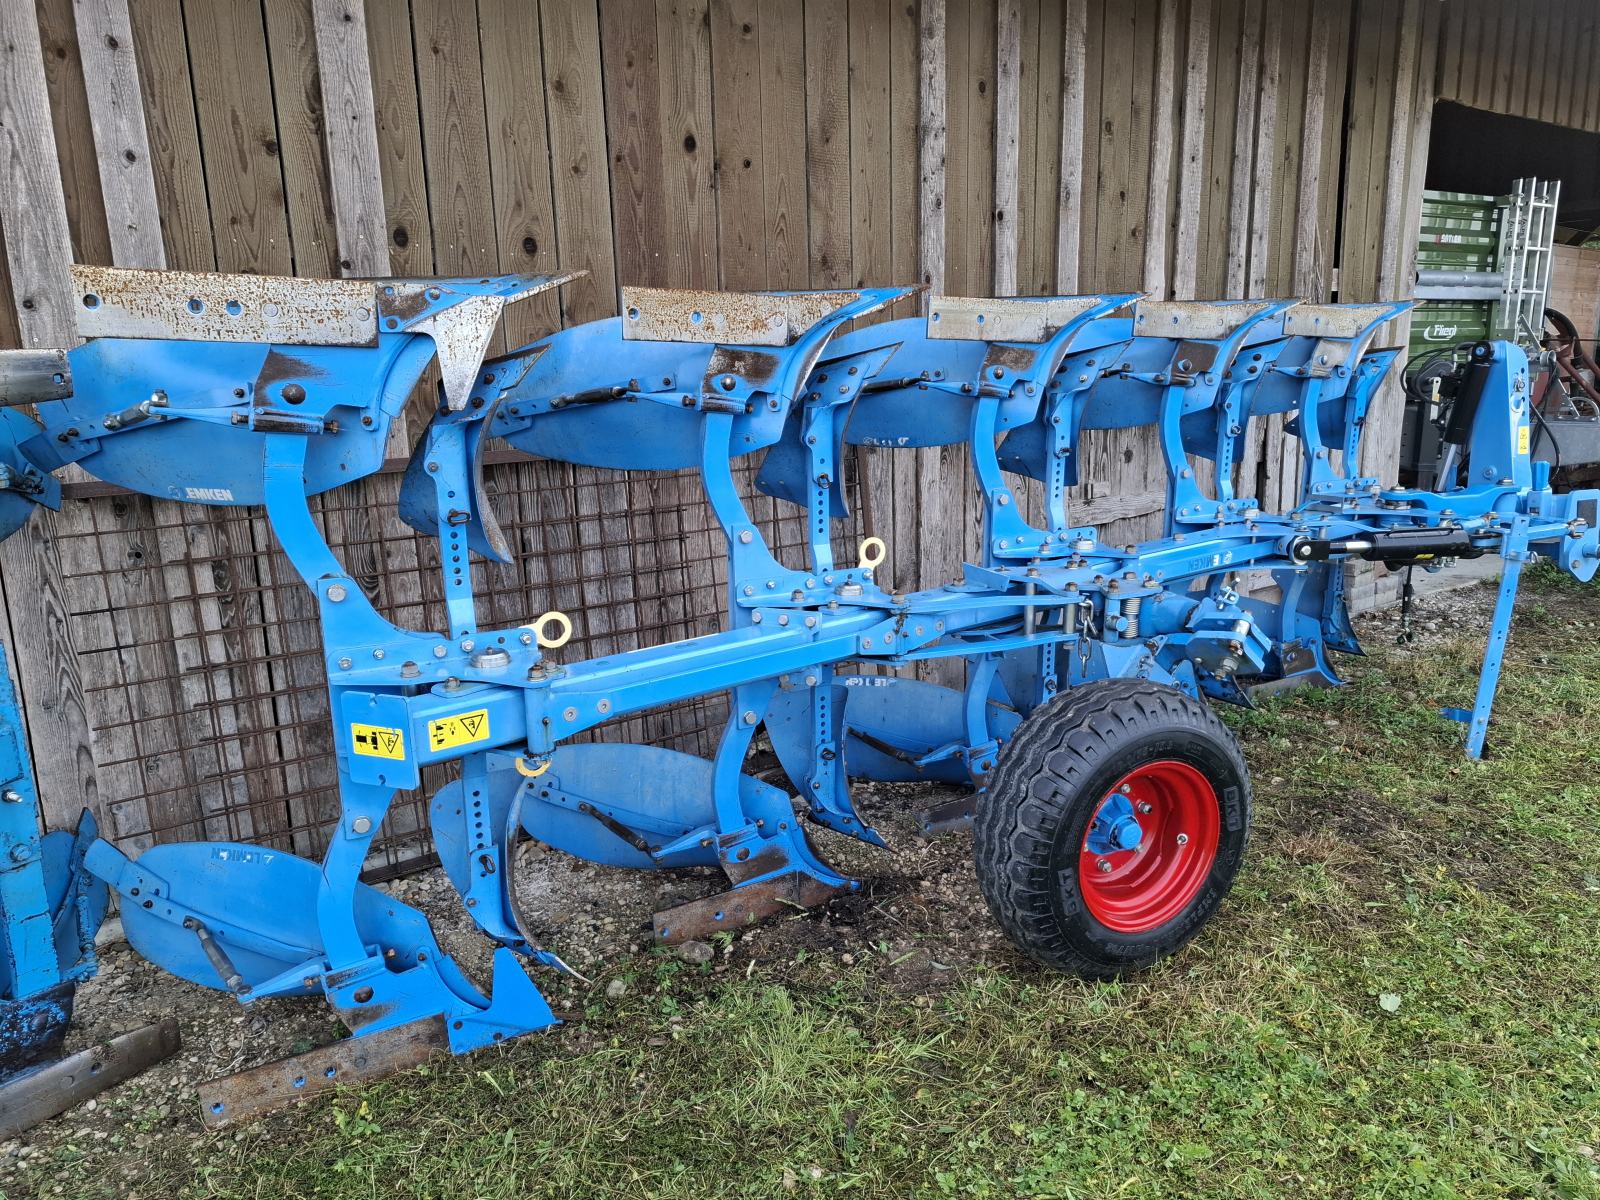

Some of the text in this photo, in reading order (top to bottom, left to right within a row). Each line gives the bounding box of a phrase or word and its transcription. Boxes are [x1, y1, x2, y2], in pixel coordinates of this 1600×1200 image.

[1433, 324, 1457, 339] Fliegl
[185, 487, 234, 502] EMKEN
[1224, 787, 1242, 831] BKT
